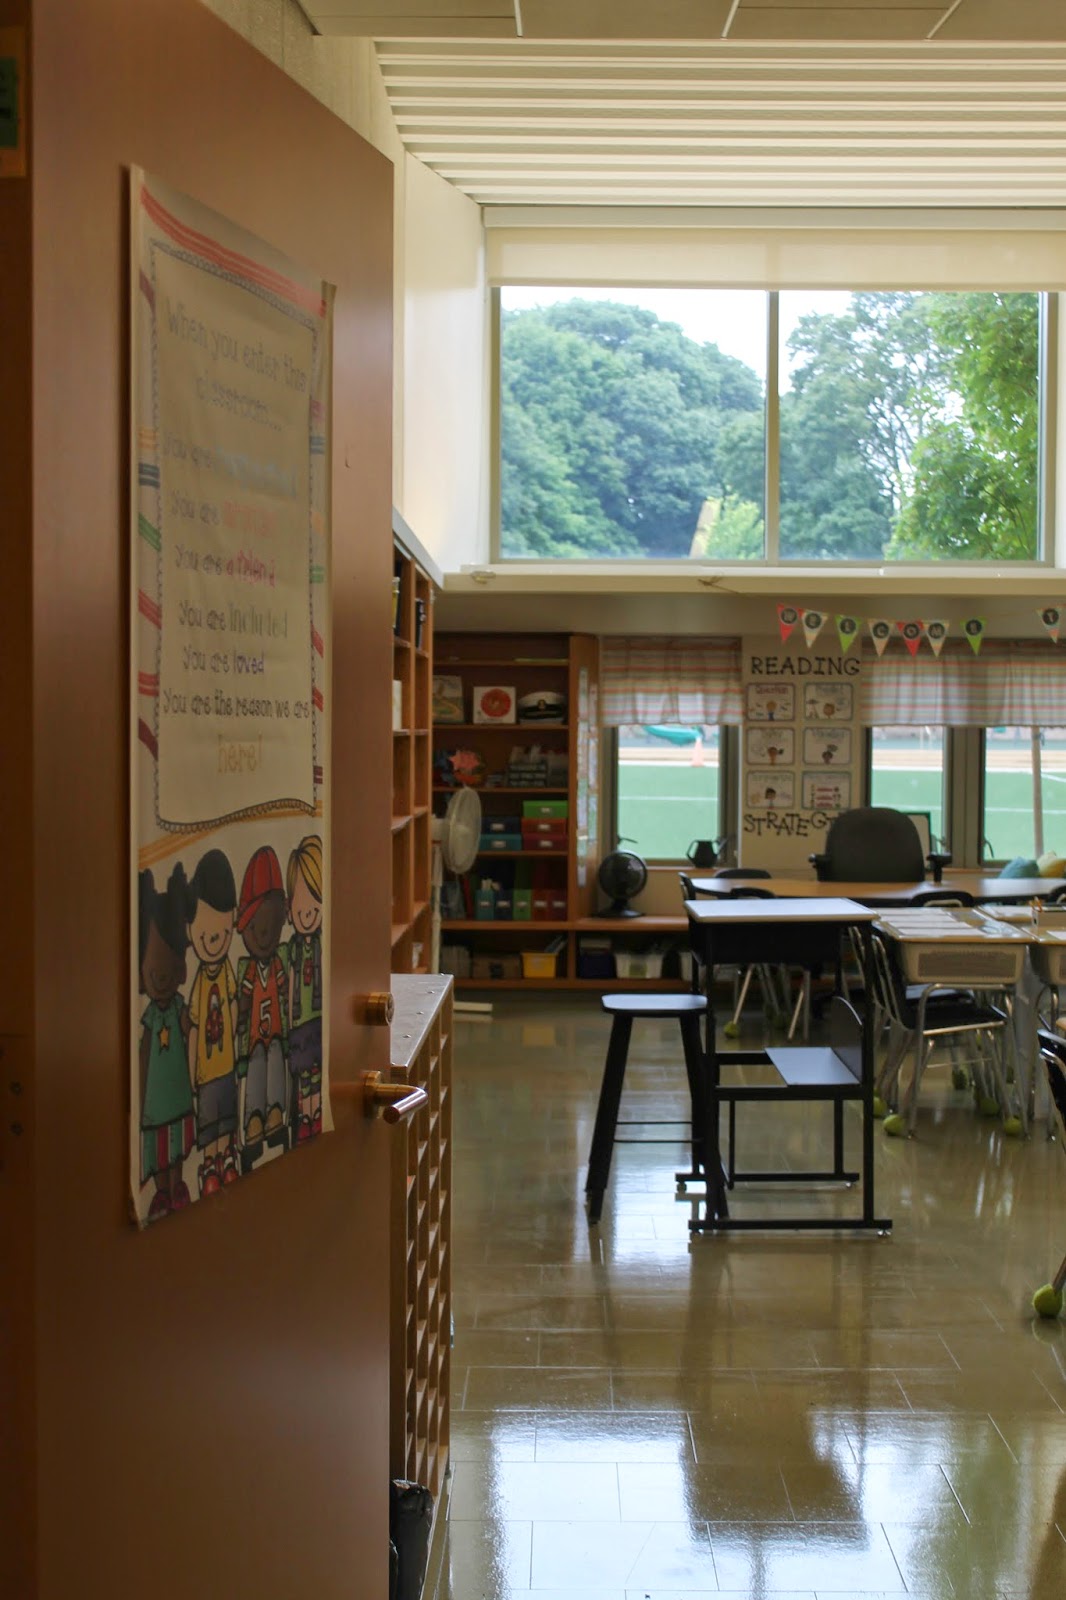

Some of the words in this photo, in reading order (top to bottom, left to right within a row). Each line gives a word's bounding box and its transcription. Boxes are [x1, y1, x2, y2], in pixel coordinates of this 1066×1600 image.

[166, 296, 208, 348] When
[211, 330, 237, 362] you
[175, 544, 199, 571] You
[202, 553, 222, 576] are
[178, 600, 202, 628] You
[206, 609, 226, 631] are
[183, 645, 206, 671] You
[210, 654, 229, 674] are
[233, 650, 265, 675] loved
[751, 656, 861, 677] READING
[163, 688, 187, 714] You
[191, 695, 212, 716] are
[214, 689, 233, 717] the
[235, 696, 273, 717] reason
[275, 700, 290, 718] we
[293, 701, 311, 719] are
